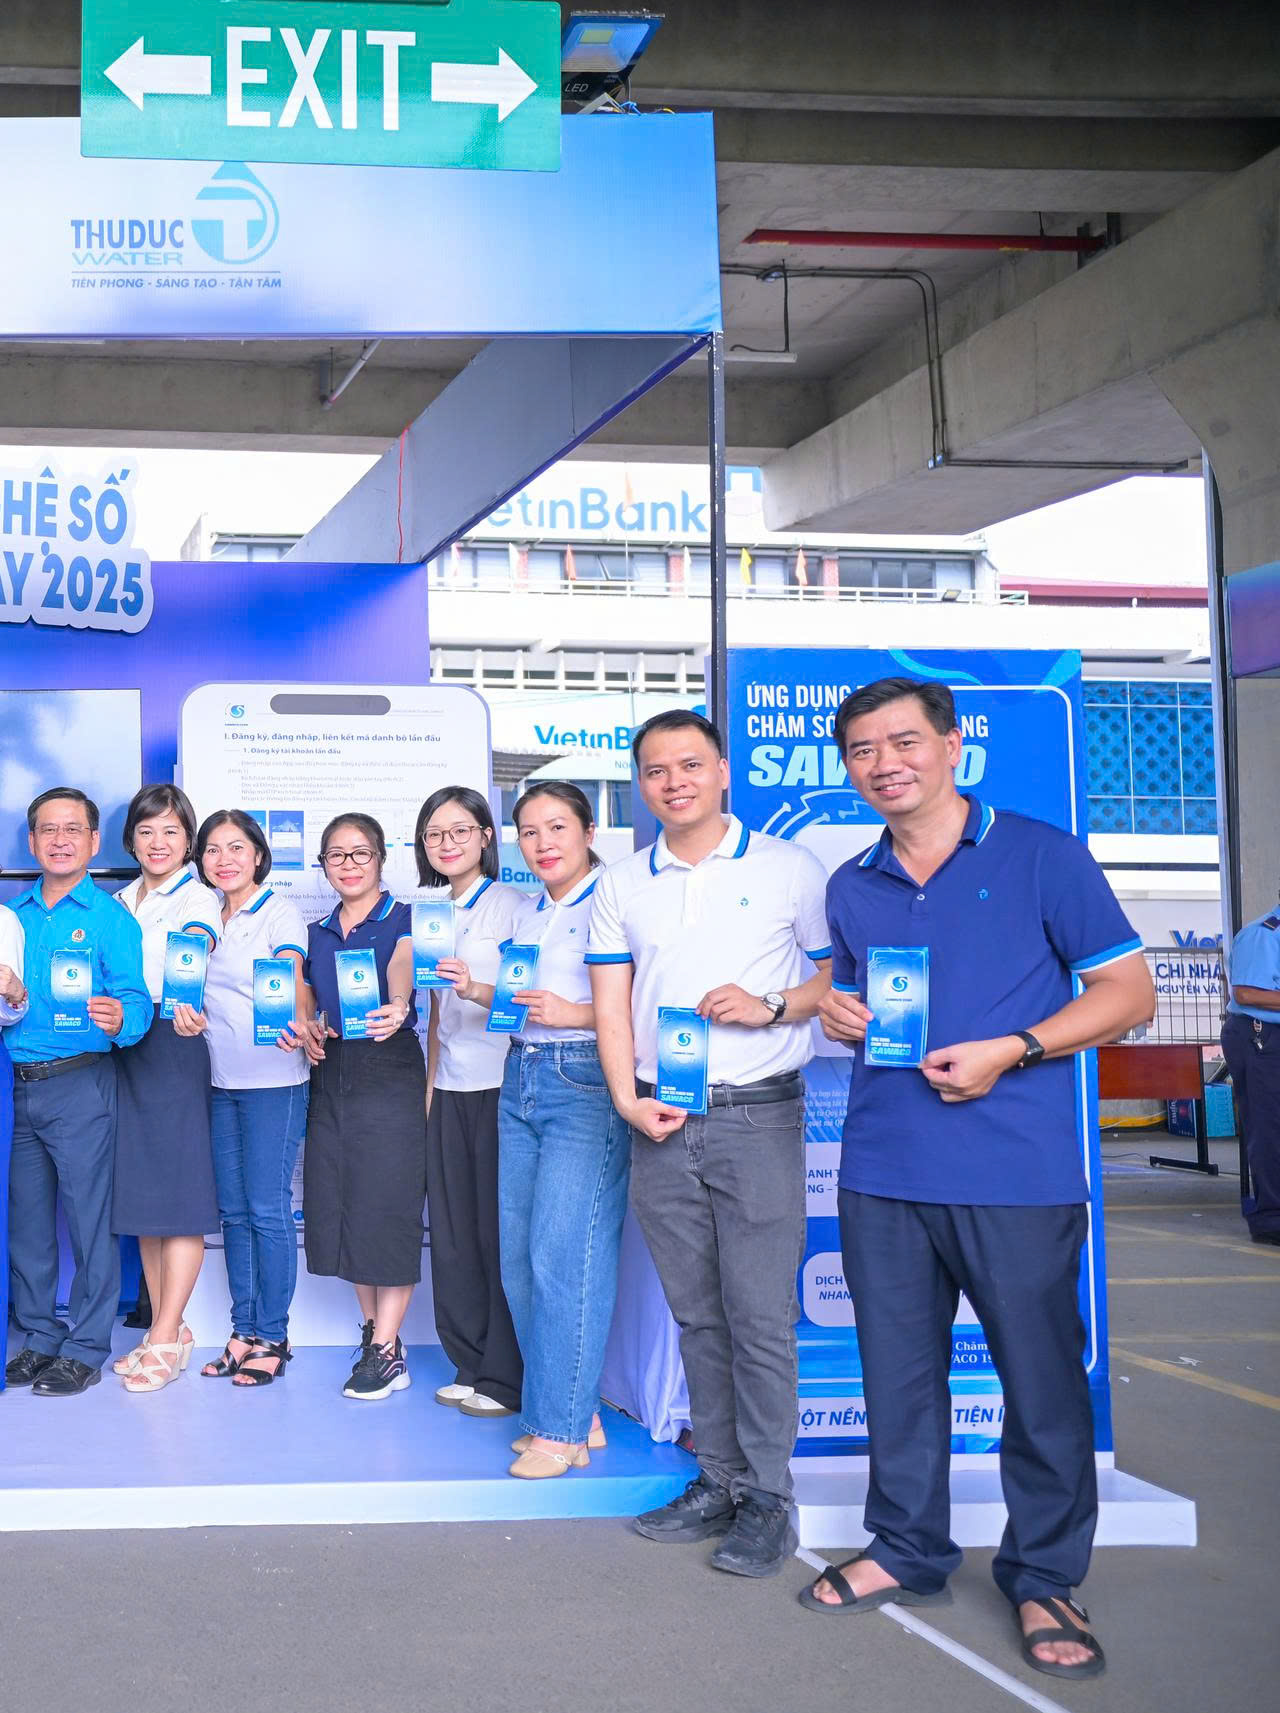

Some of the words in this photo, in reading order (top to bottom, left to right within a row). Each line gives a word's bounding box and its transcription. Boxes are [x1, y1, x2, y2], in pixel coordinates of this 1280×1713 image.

[226, 26, 416, 131] EXIT
[564, 83, 589, 93] LED
[71, 219, 184, 249] THUDUC
[72, 251, 183, 266] WATER
[99, 278, 144, 289] PHONG
[156, 275, 190, 289] SÁNG
[67, 468, 131, 546] SỐ
[486, 487, 709, 533] etinBank
[40, 552, 145, 618] 2025
[746, 682, 789, 708] ỨNG
[746, 713, 806, 738] CHĂM
[812, 712, 836, 738] SÓ
[534, 725, 631, 750] VietinB
[1156, 963, 1185, 979] CHI
[871, 1046, 912, 1056] SAWACO
[661, 1094, 694, 1103] SAWACO
[807, 1168, 833, 1179] ANH
[815, 1275, 843, 1289] DỊCH
[819, 1290, 852, 1301] NHAN
[955, 1341, 988, 1352] Chăm
[951, 1354, 978, 1364] ACO
[799, 1408, 828, 1431] ỘT
[828, 1406, 867, 1426] NỀN
[954, 1406, 995, 1427] TIỆN
